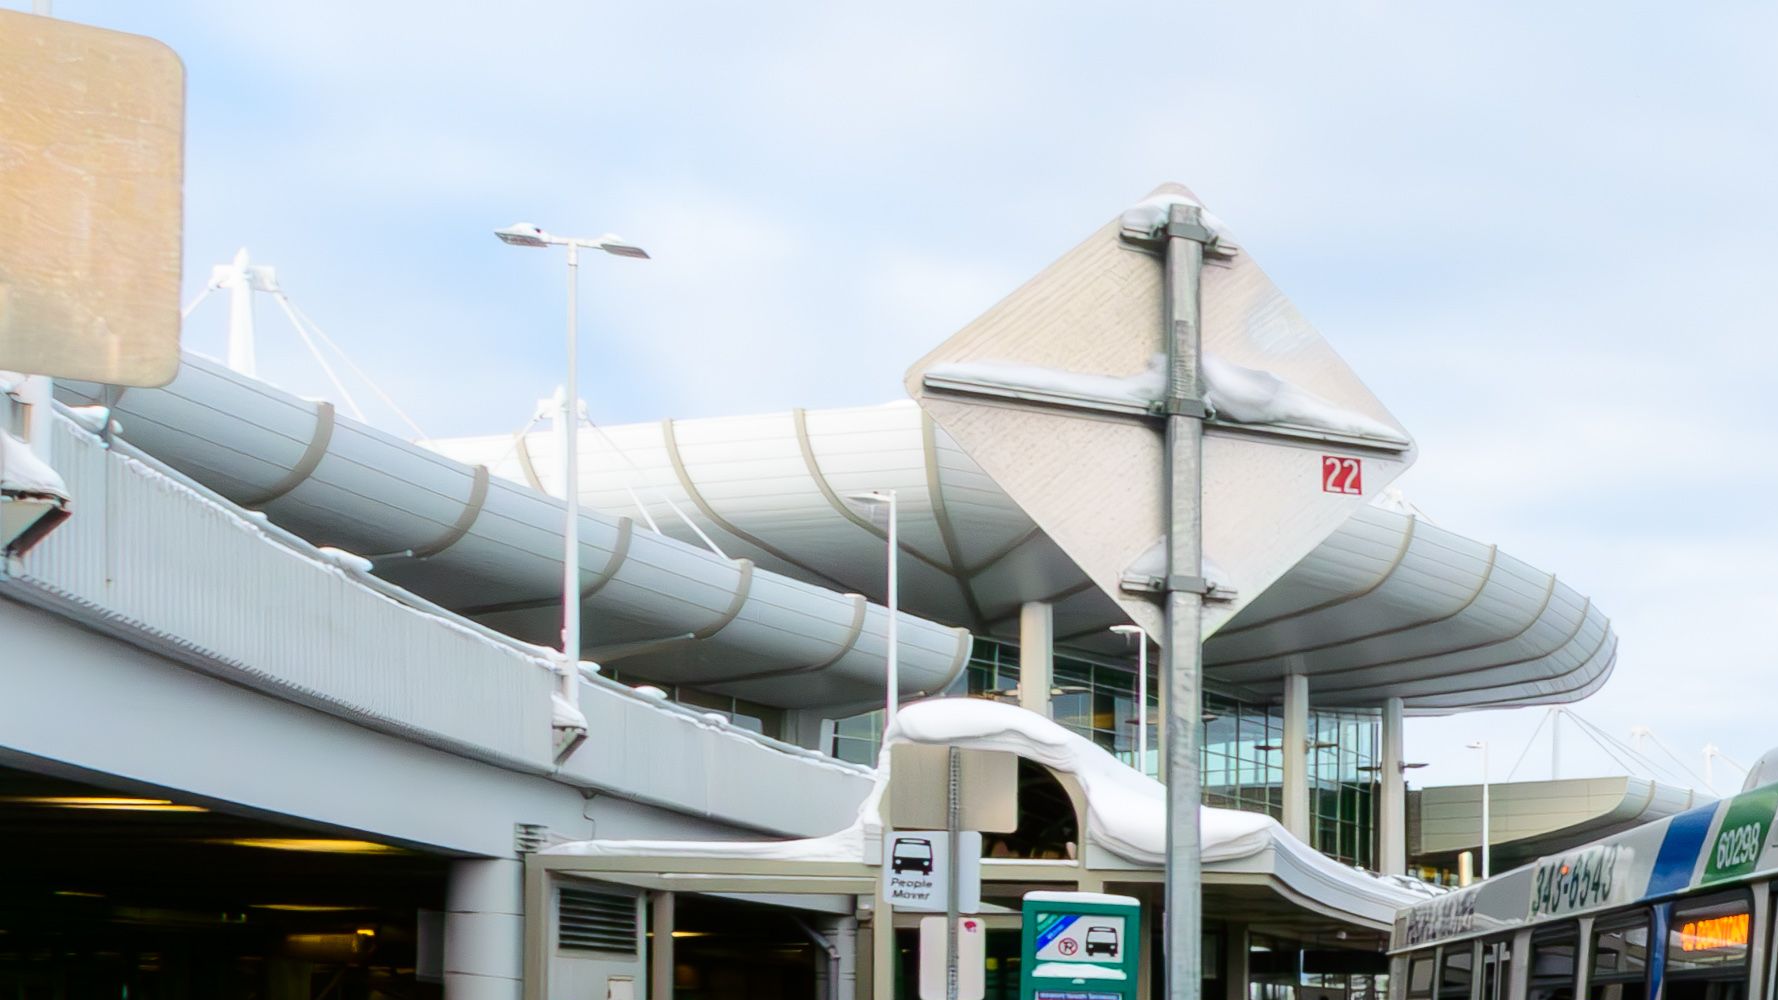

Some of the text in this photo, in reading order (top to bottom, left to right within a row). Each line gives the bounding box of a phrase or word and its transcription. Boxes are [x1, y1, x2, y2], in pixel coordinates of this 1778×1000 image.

[1325, 457, 1360, 494] 22
[1716, 821, 1762, 870] 60298
[890, 877, 933, 889] People
[892, 889, 931, 901] Mover
[1532, 844, 1619, 913] 343-6543
